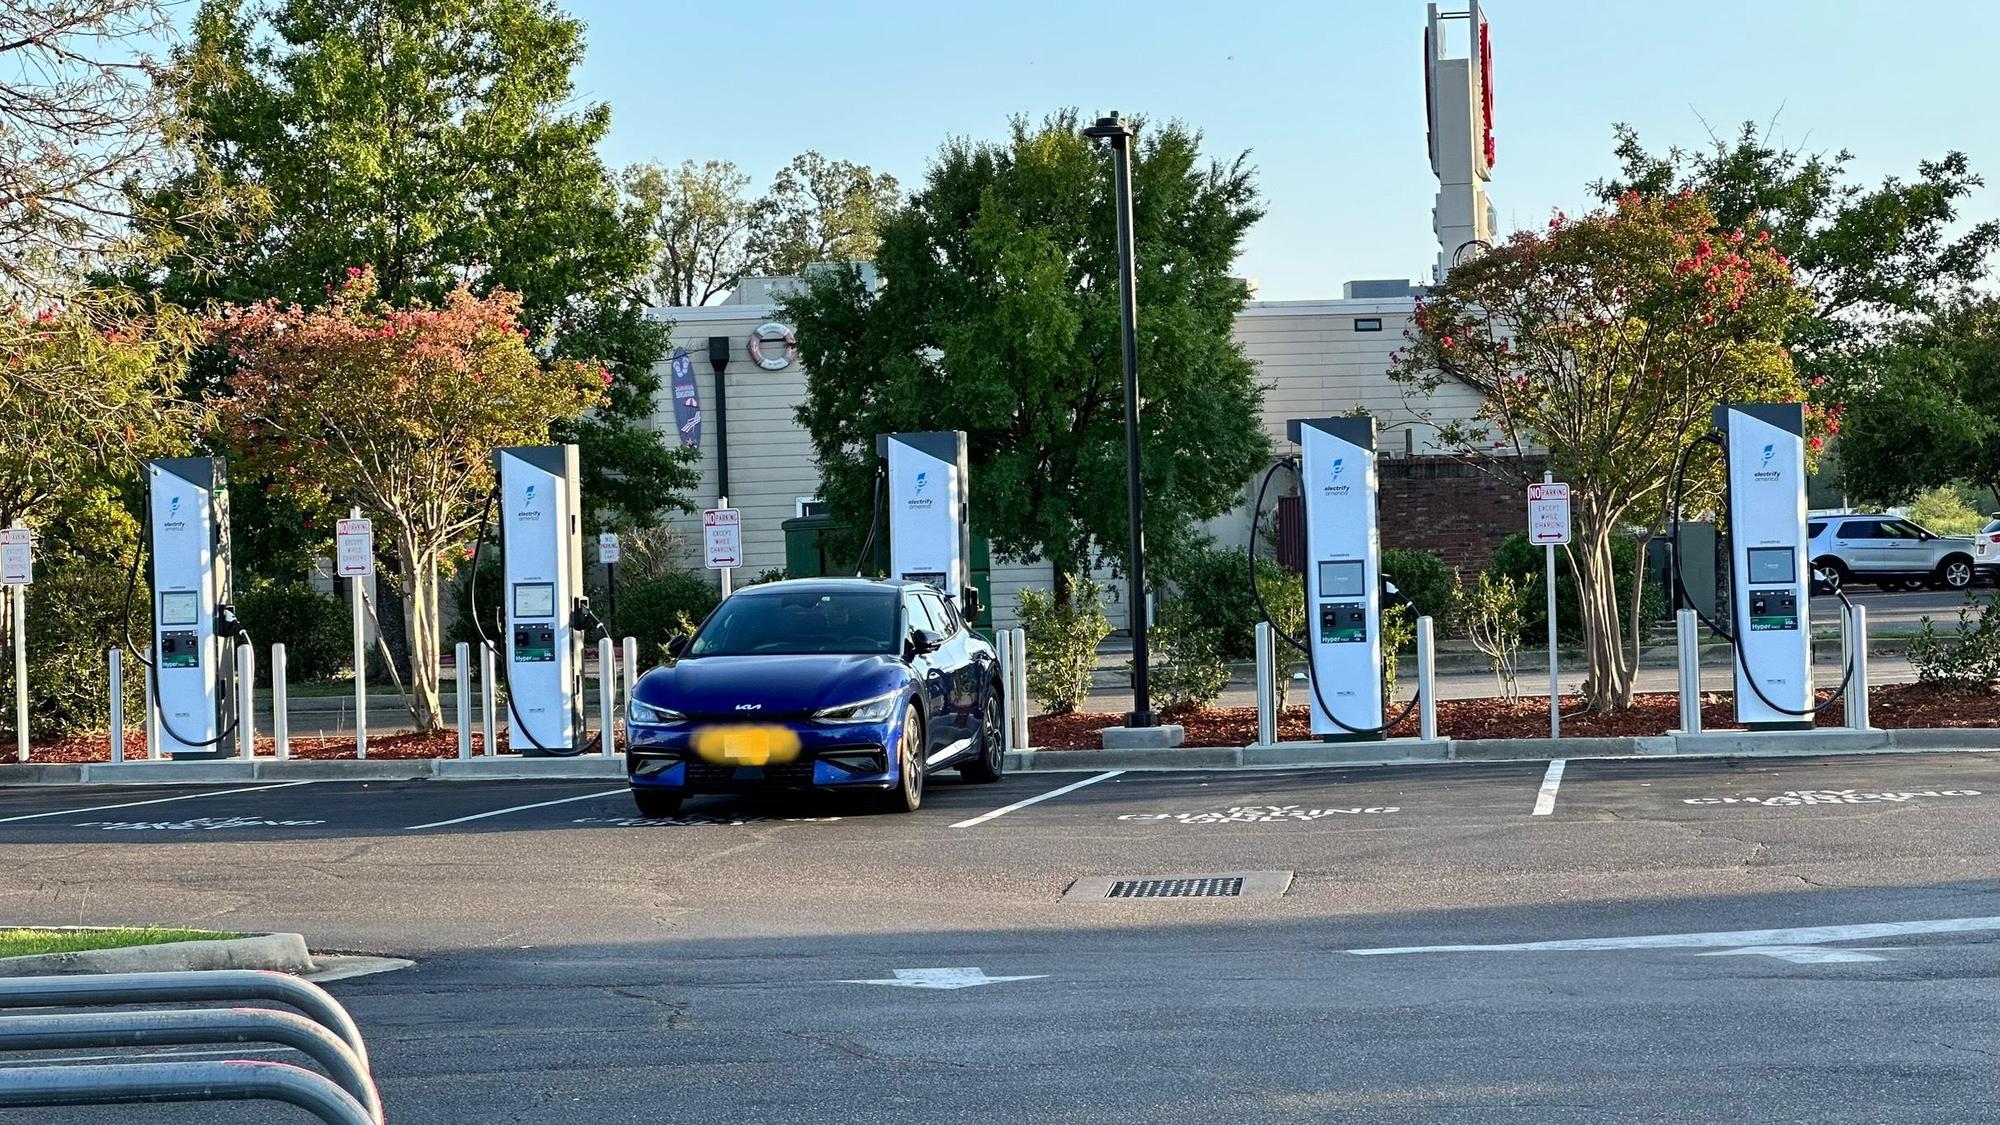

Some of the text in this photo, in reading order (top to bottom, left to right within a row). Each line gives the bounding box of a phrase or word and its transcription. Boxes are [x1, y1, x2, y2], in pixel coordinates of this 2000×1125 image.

[1530, 486, 1566, 499] NO PARKING
[705, 513, 737, 525] NO PARKING
